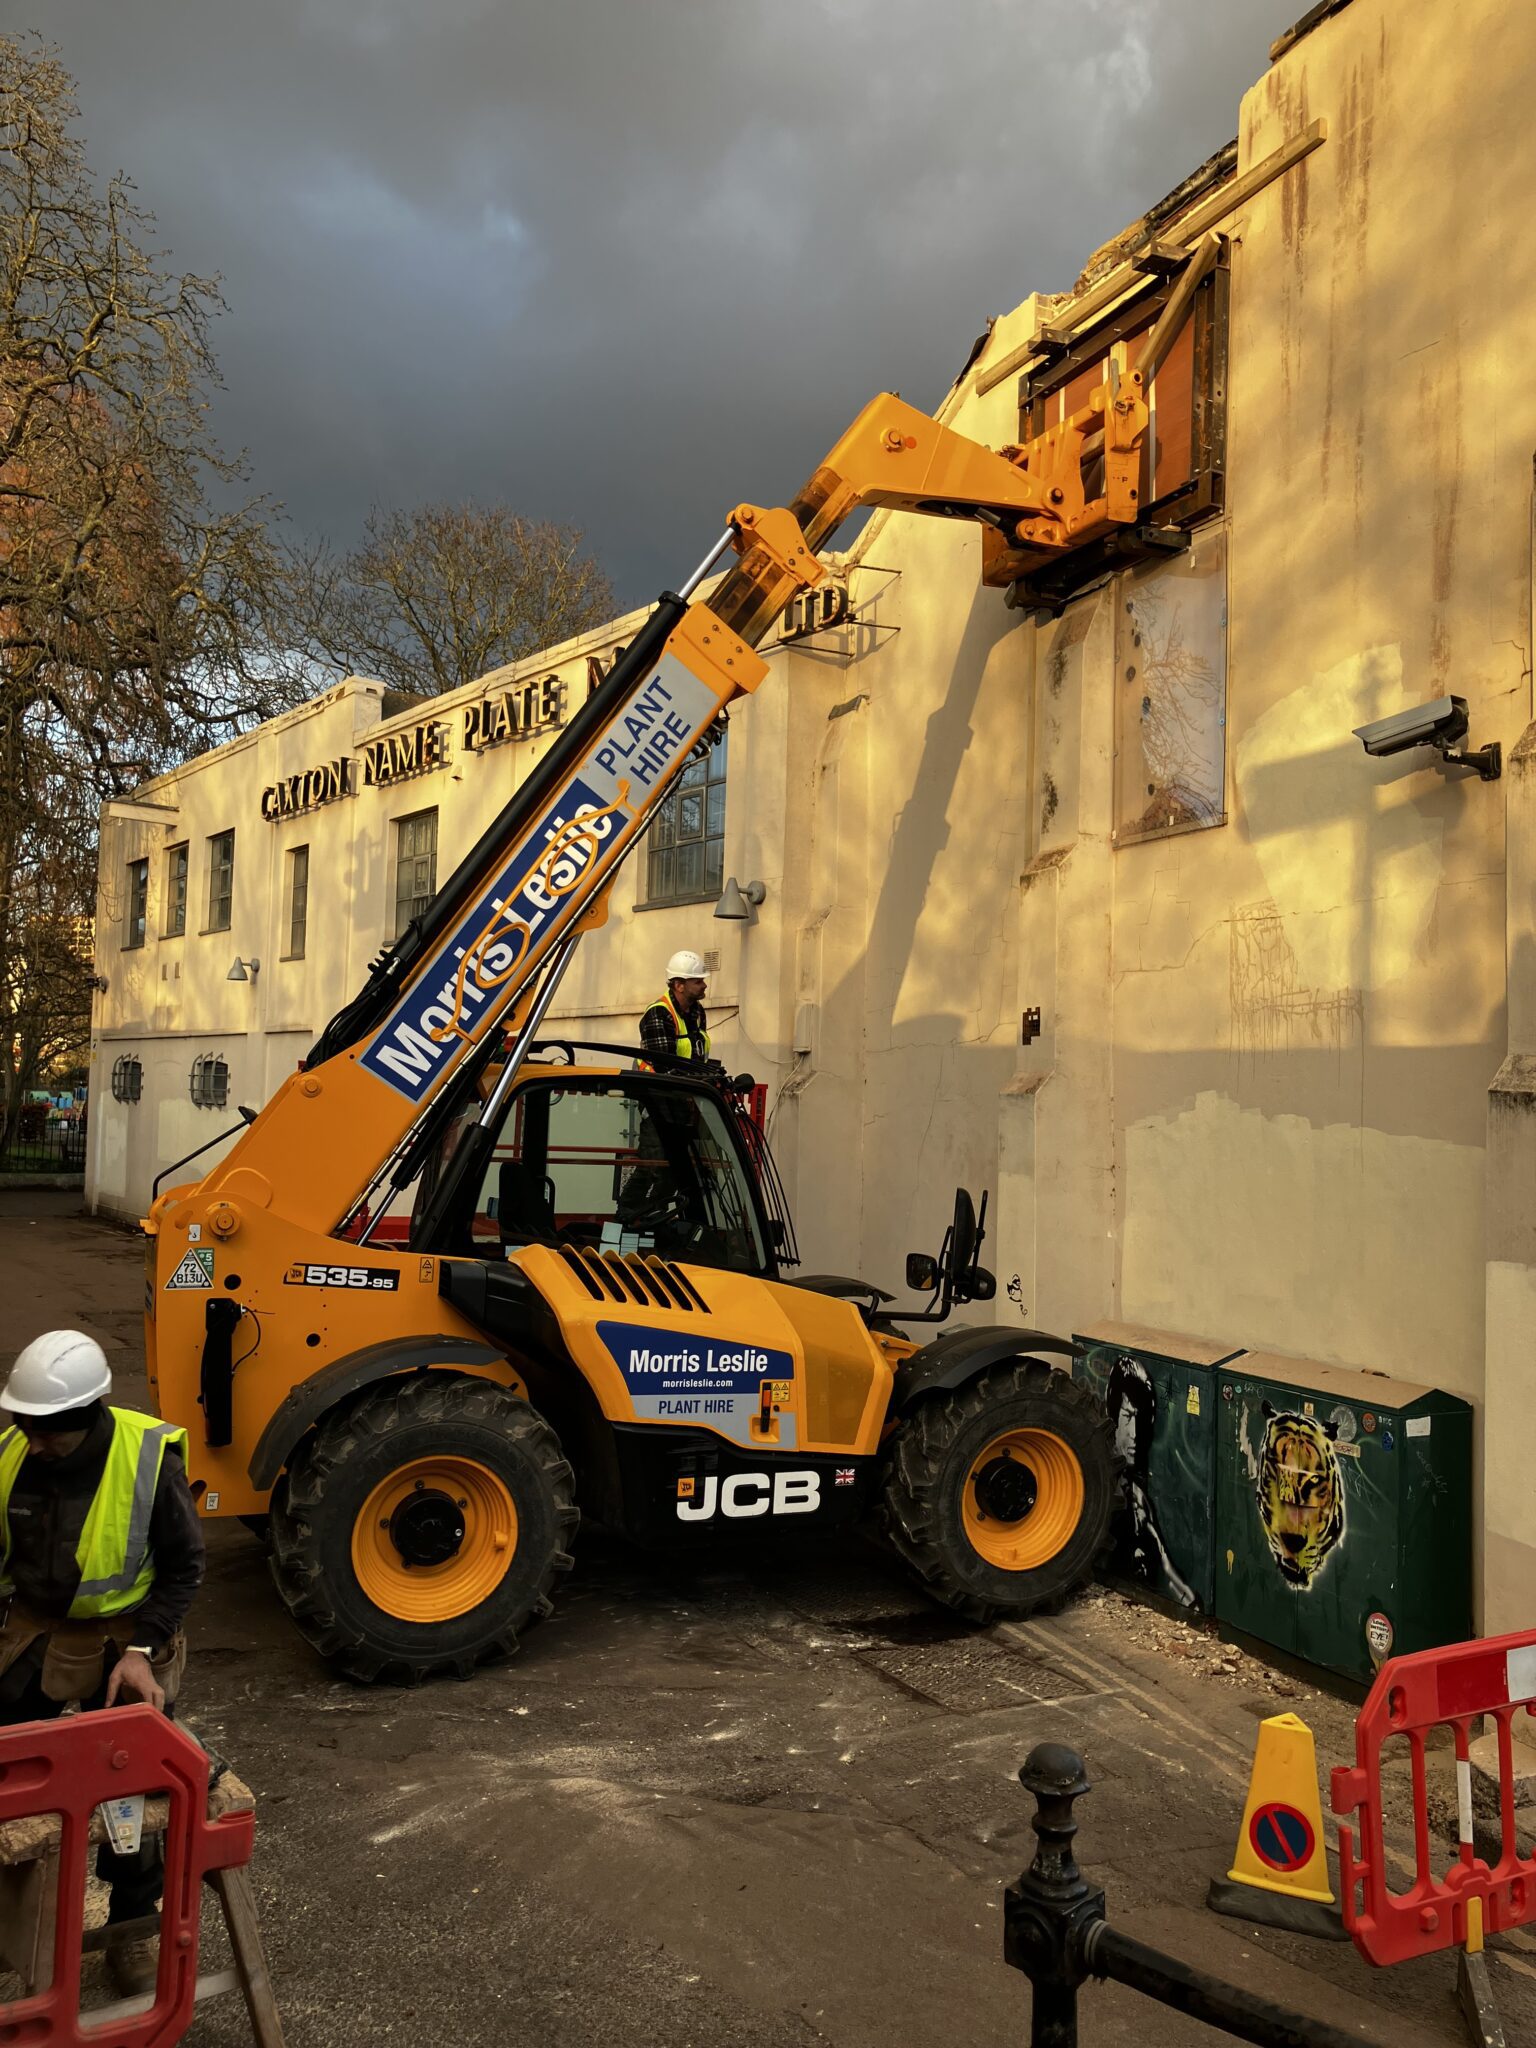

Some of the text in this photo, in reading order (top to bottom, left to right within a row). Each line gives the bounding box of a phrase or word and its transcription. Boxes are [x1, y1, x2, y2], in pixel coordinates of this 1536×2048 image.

[595, 675, 673, 776] PLANT
[261, 757, 350, 819] CAXTON
[363, 721, 441, 786] NAME
[462, 674, 561, 751] PLATE
[630, 711, 691, 786] HIRE
[376, 802, 613, 1087] Morris Leslie
[184, 1263, 197, 1273] 72
[306, 1265, 394, 1289] 535-95
[629, 1350, 768, 1373] Morris Leslie
[662, 1378, 733, 1388] morrisleslie.com
[658, 1399, 734, 1415] PLANT HIRE
[676, 1470, 821, 1521] JCB
